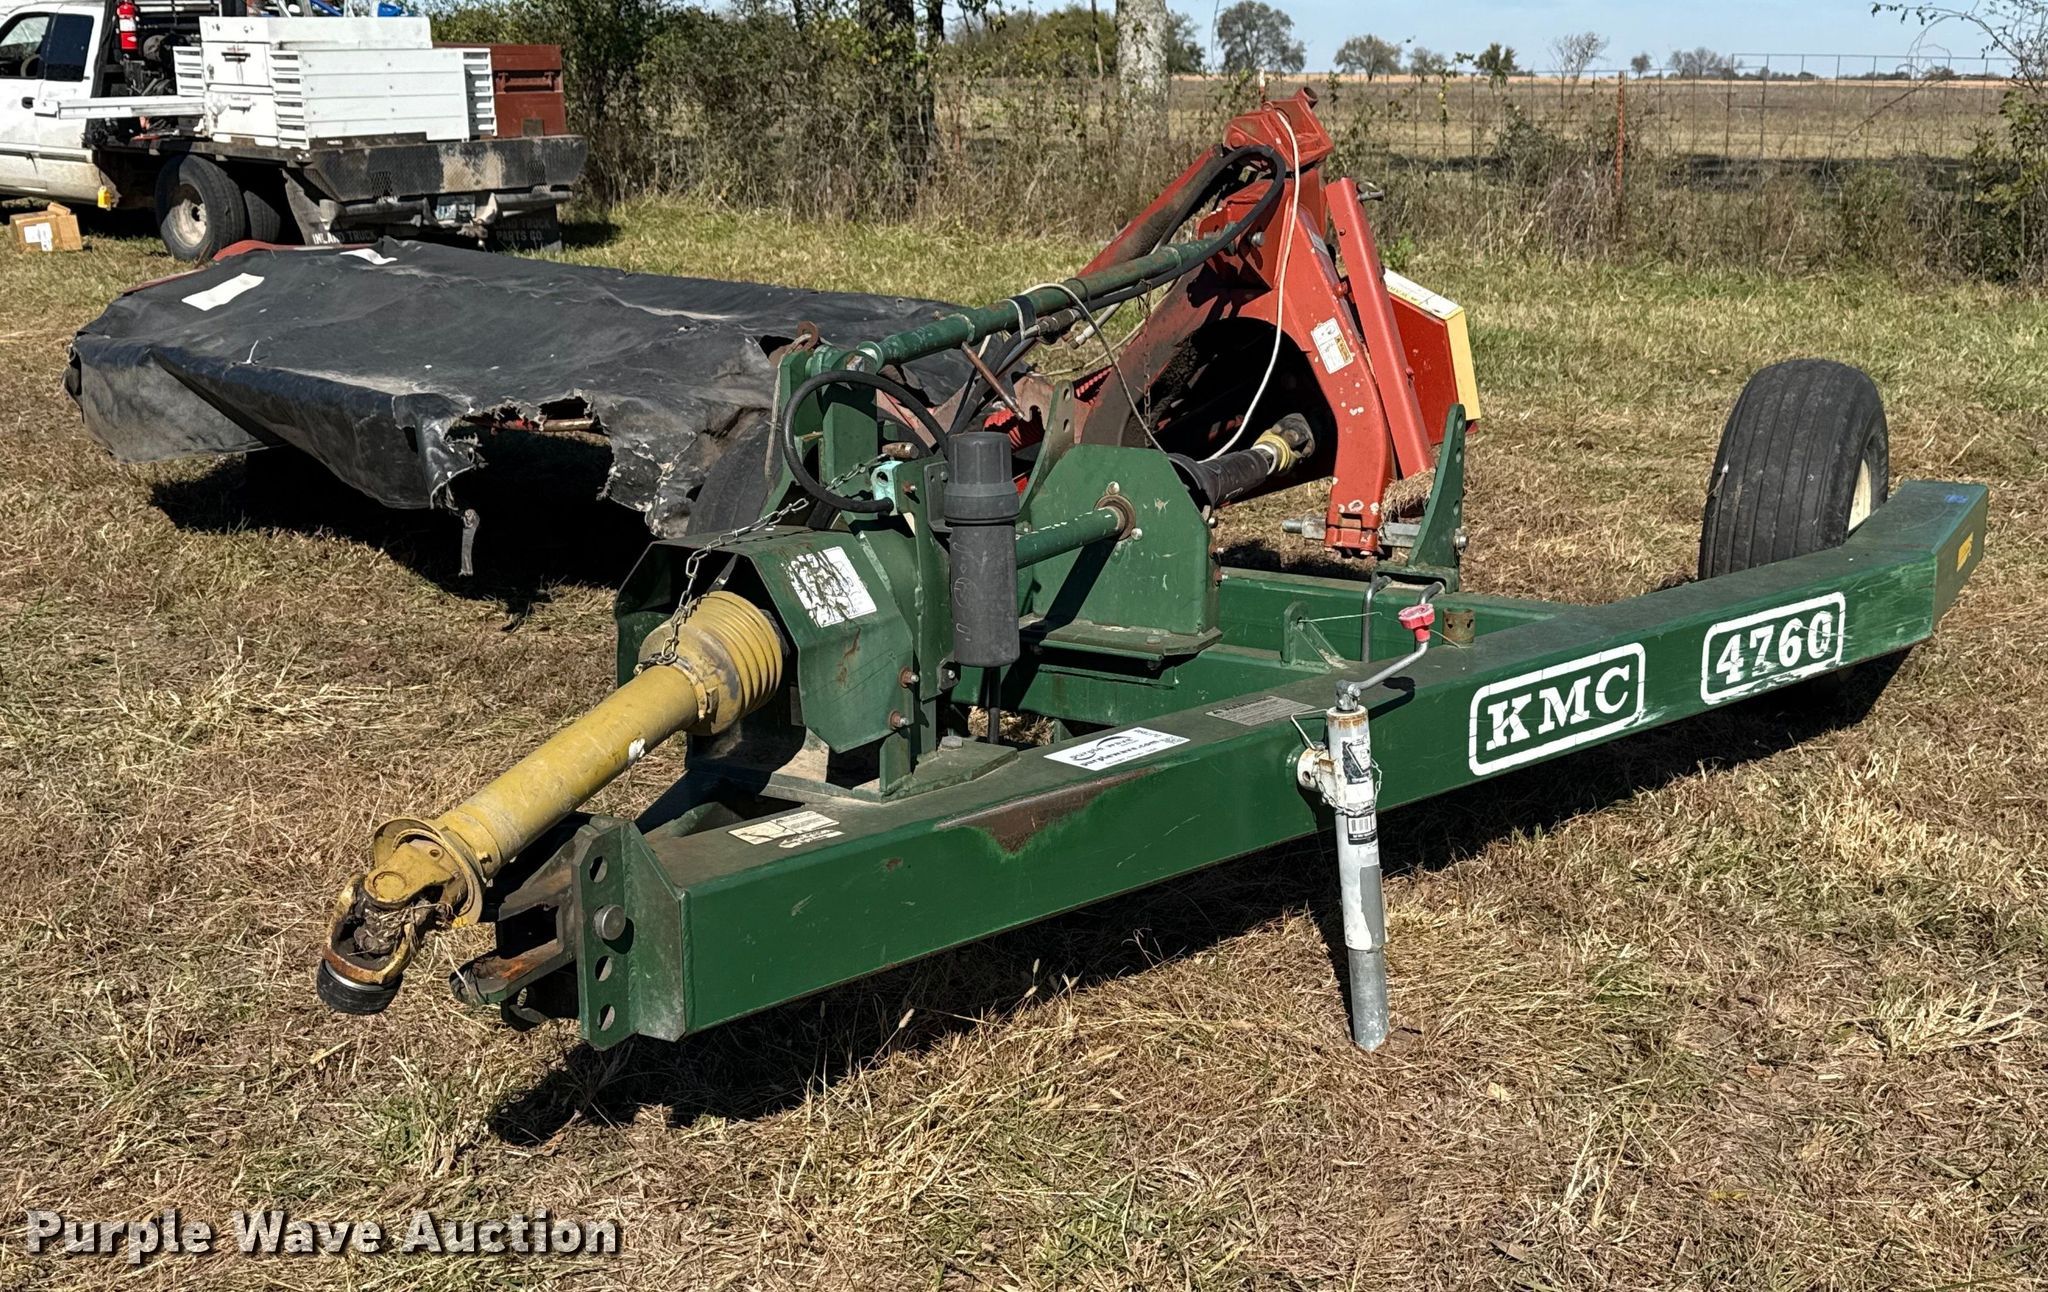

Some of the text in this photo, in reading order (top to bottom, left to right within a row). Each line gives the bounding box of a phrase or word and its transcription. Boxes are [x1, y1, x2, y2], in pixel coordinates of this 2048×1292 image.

[519, 217, 551, 229] TRUCK
[312, 231, 345, 245] INLAND
[496, 230, 527, 241] PARTS
[1716, 610, 1833, 685] 4760
[1486, 664, 1630, 752] KMC
